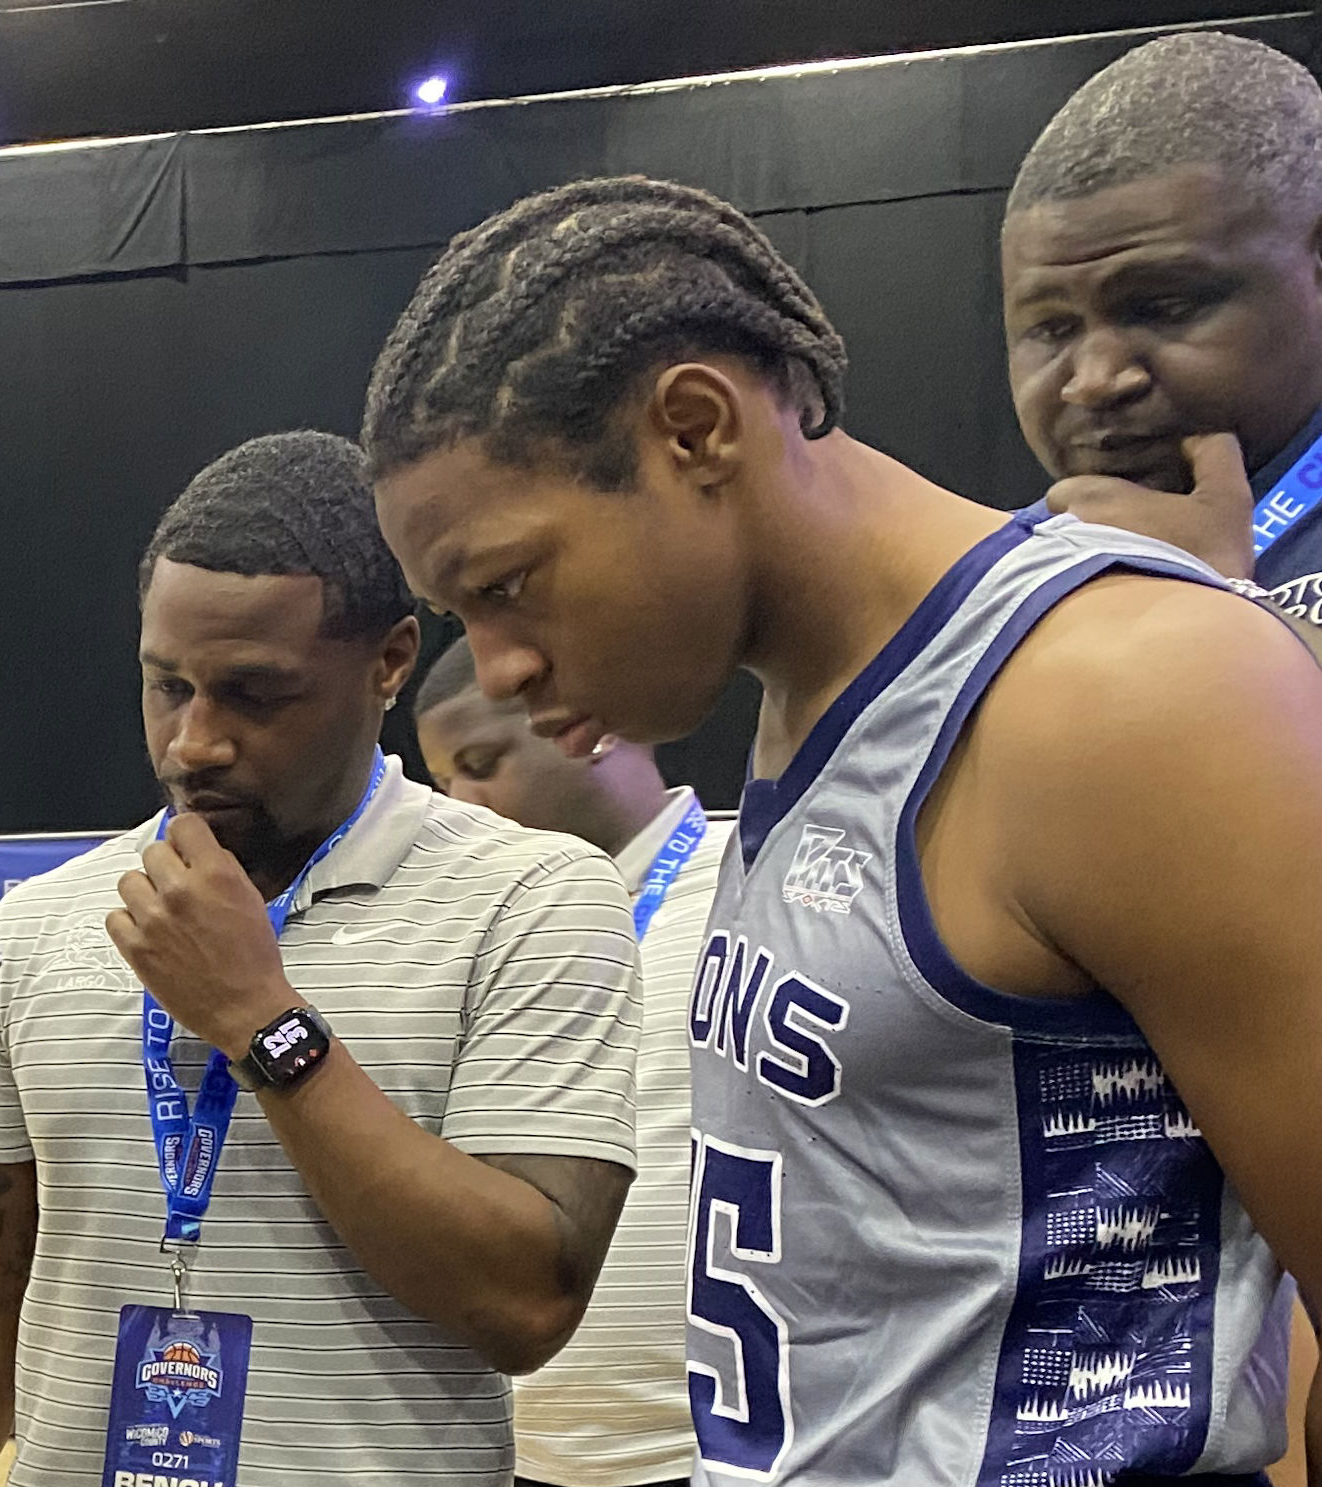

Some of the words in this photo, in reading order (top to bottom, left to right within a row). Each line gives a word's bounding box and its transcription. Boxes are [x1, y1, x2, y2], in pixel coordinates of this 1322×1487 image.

[1253, 490, 1306, 551] HE
[668, 831, 696, 854] TO
[644, 858, 680, 896] THE
[57, 975, 105, 989] LARGO
[147, 1008, 170, 1048] TO
[278, 1018, 308, 1045] 31
[263, 1031, 292, 1059] 12
[148, 1057, 183, 1122] RISE
[184, 1128, 213, 1197] GOVERNORS
[142, 1361, 218, 1389] GOVERNORS
[152, 1452, 189, 1469] 0271
